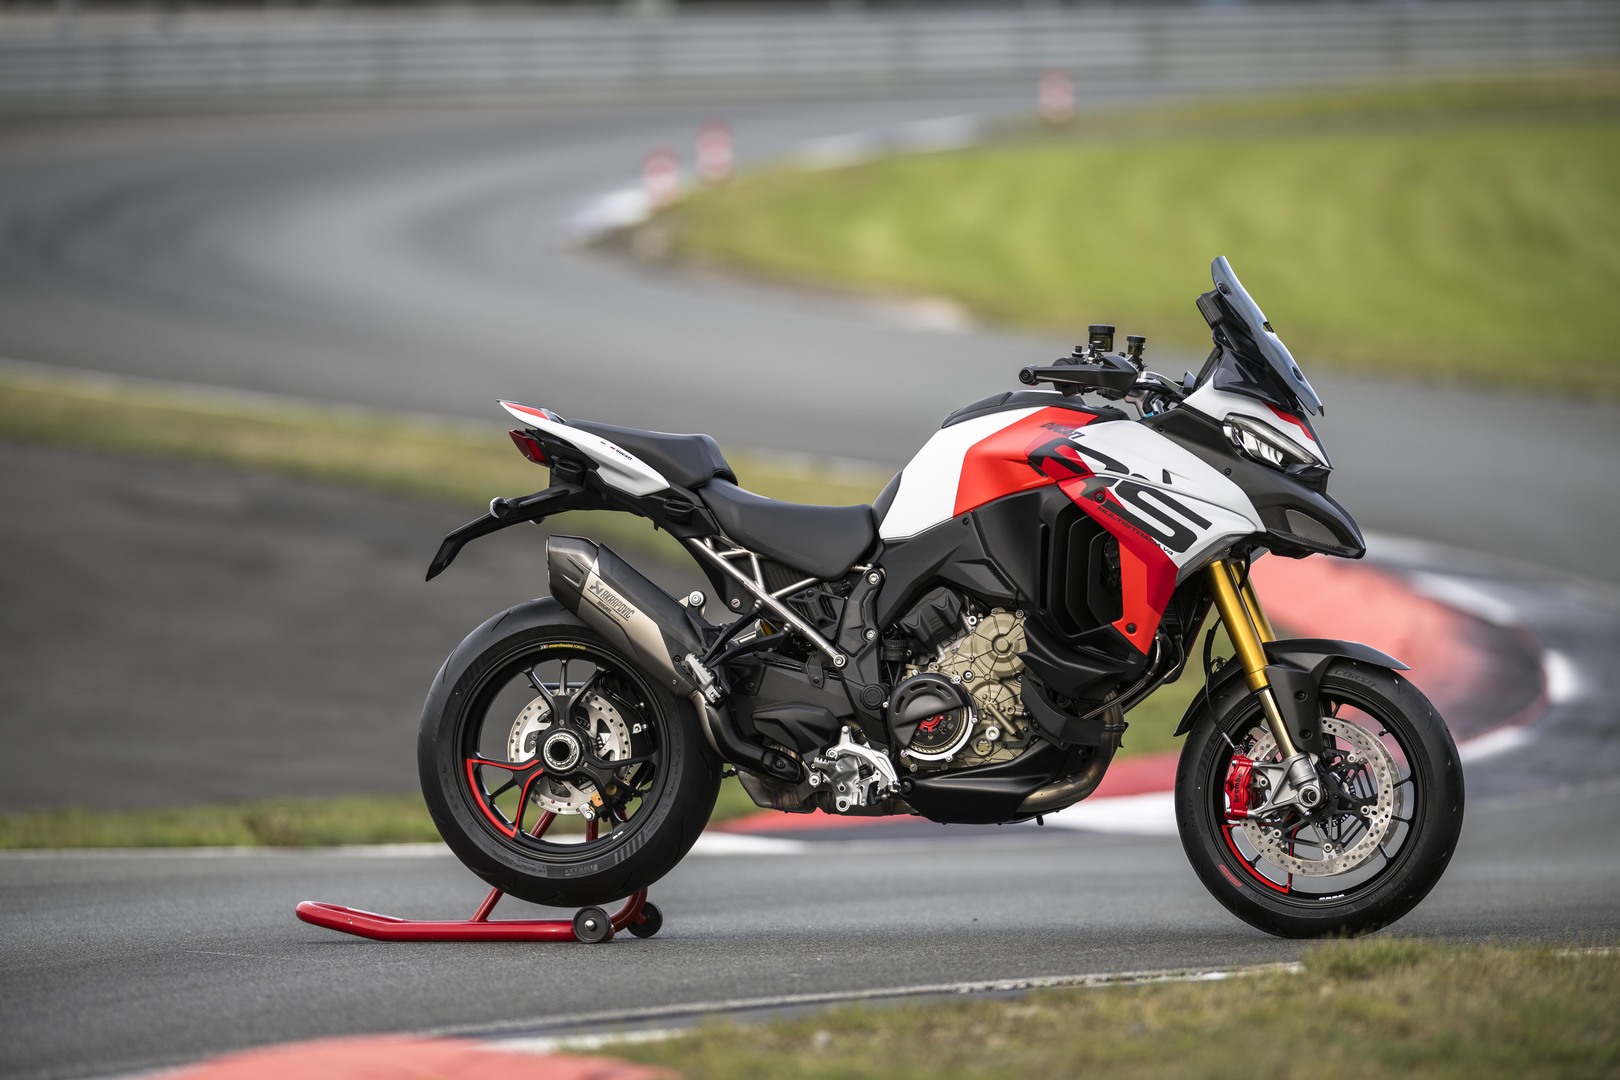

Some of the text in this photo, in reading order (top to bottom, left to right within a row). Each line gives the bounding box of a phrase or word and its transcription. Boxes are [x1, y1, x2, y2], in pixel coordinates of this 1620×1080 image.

[1040, 422, 1086, 440] DUCATI
[1097, 505, 1162, 550] MULTISTRADA
[1233, 773, 1243, 803] brembo
